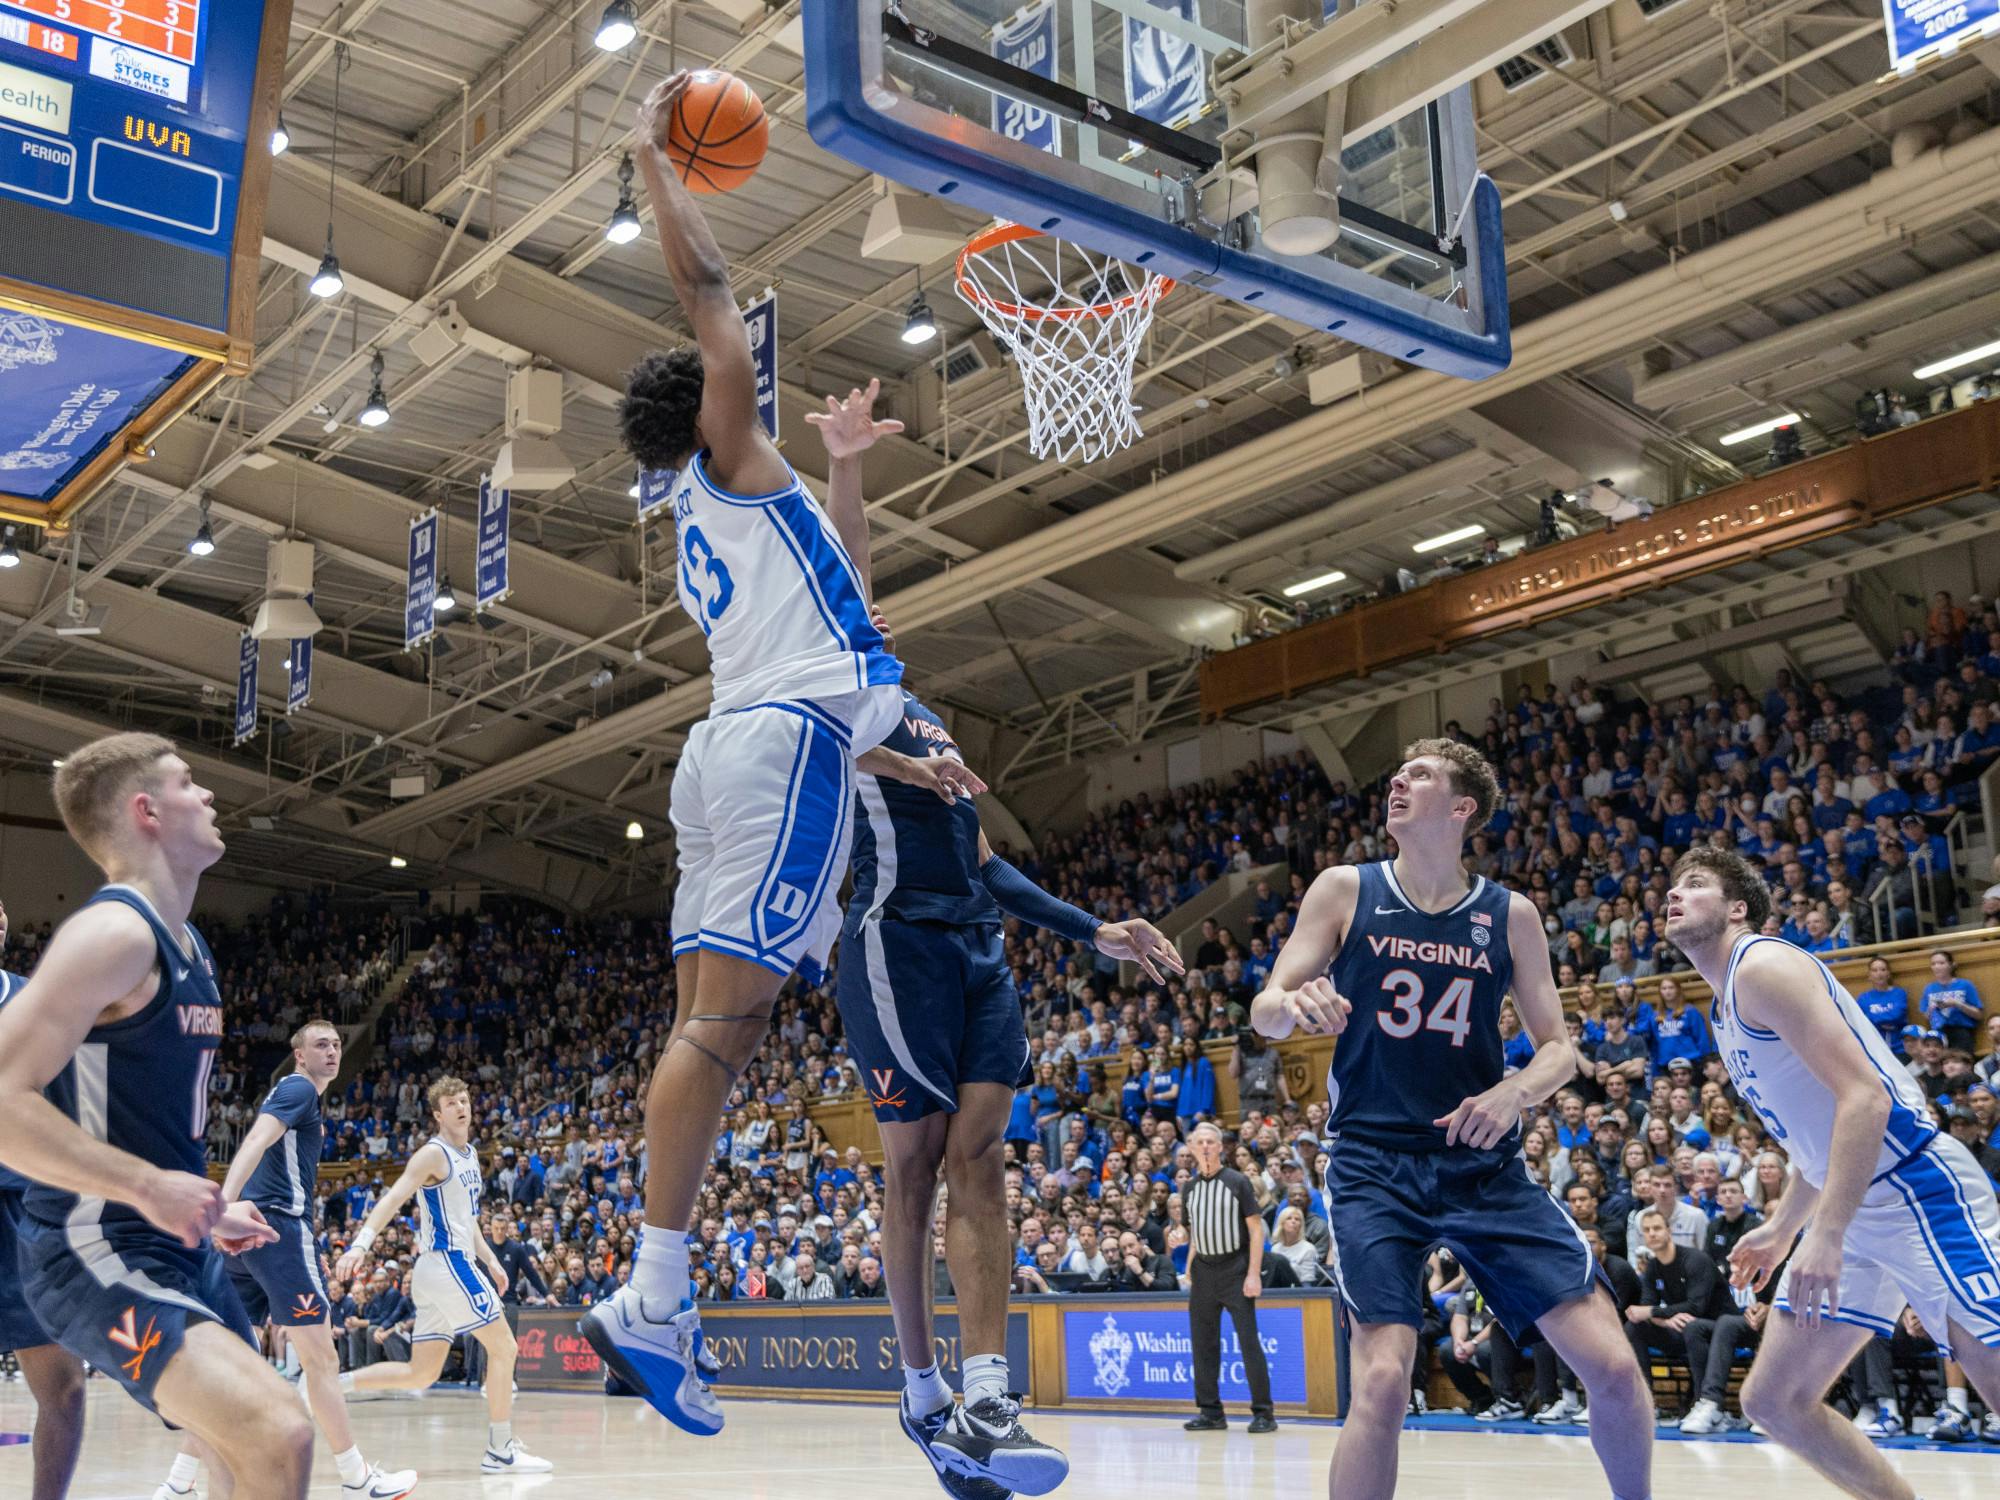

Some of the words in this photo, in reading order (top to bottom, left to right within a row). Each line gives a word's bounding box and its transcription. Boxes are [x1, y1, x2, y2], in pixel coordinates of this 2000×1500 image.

[164, 2, 180, 26] 3
[41, 29, 65, 53] 18
[107, 11, 123, 37] 2
[165, 30, 174, 53] 1
[114, 62, 171, 89] STORES
[123, 114, 191, 157] UVA
[22, 141, 71, 166] PERIOD
[1589, 527, 1688, 573] INDOOR
[1696, 482, 1824, 543] STADIUM
[1366, 935, 1493, 975] VIRGINIA
[1376, 968, 1474, 1047] 34
[761, 1336, 860, 1370] INDOOR
[1233, 1332, 1278, 1355] Dke
[562, 1355, 601, 1373] SUGAR
[1144, 1360, 1169, 1383] Inn
[1173, 1361, 1189, 1383] &
